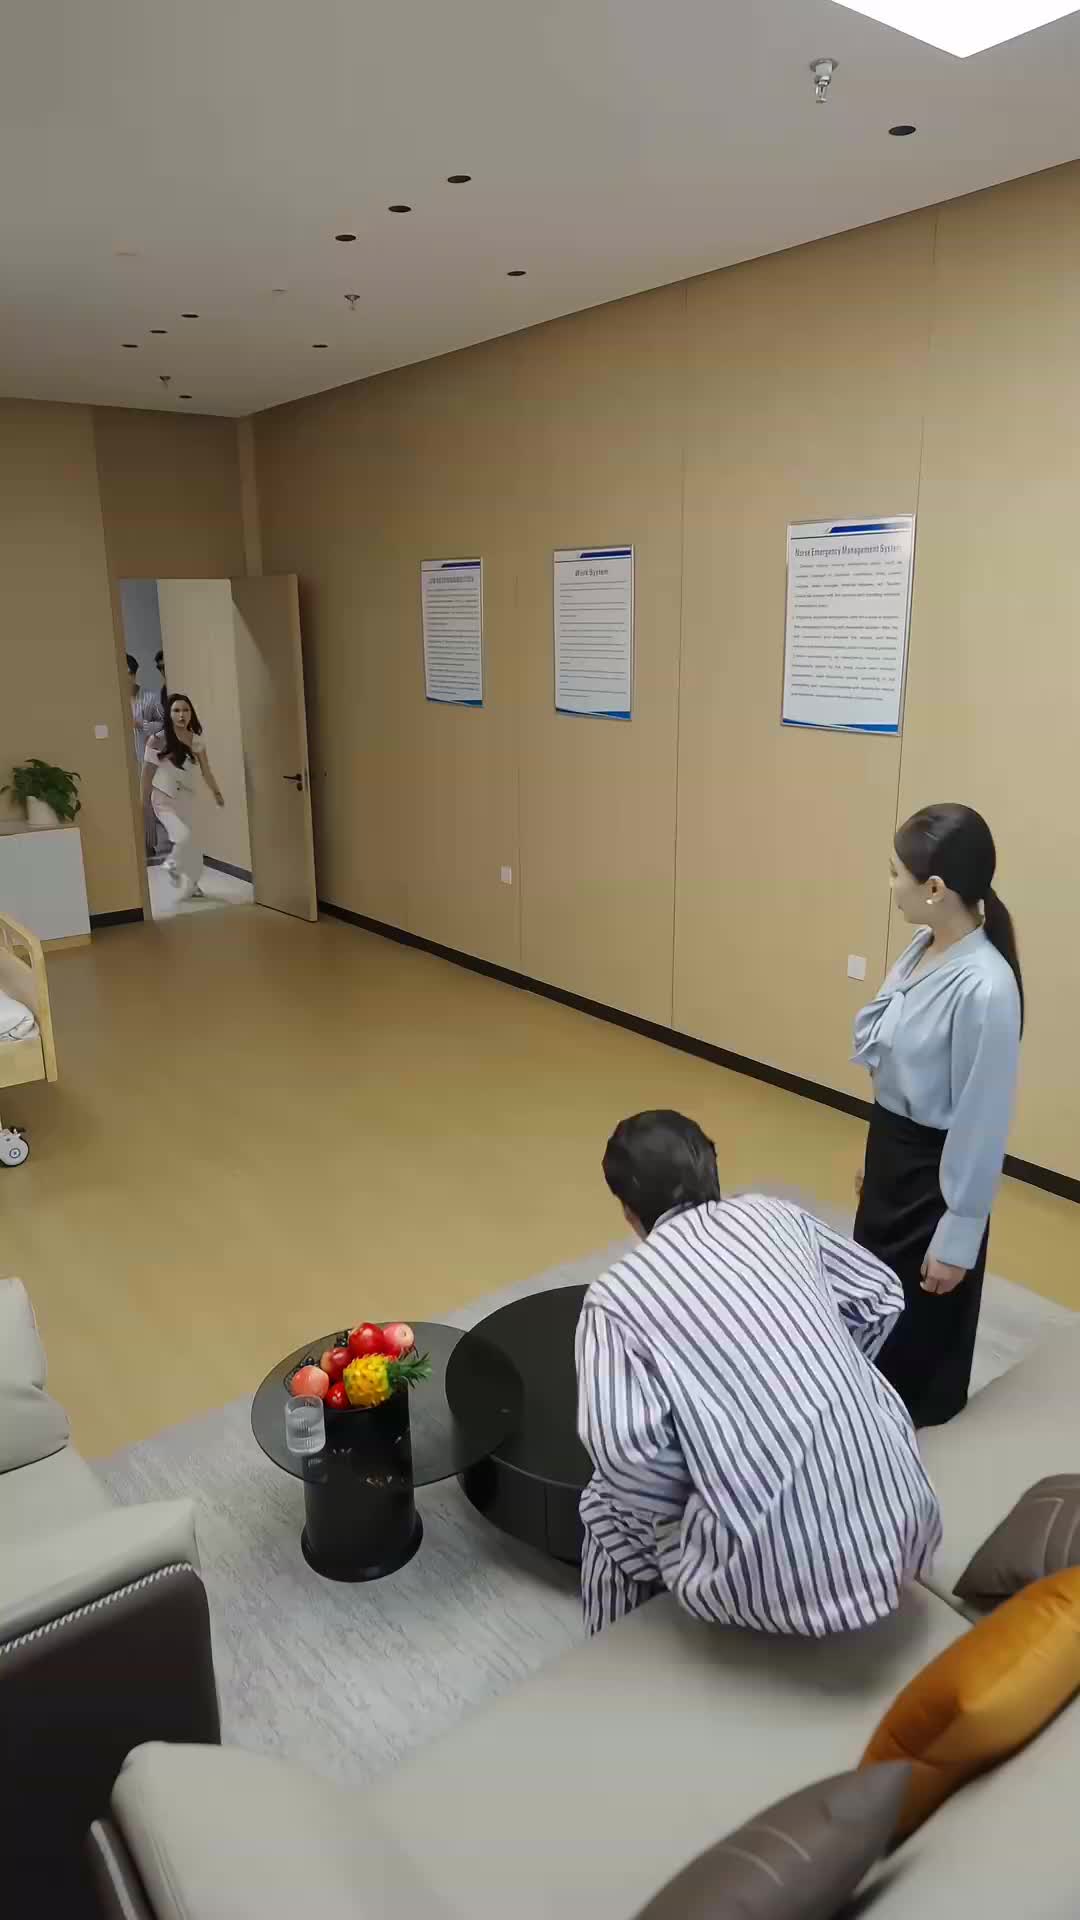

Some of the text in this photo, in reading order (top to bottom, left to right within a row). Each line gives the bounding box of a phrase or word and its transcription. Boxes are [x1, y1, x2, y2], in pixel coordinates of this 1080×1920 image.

[811, 547, 840, 558] Emergency
[842, 544, 880, 557] Management
[589, 567, 609, 577] System
